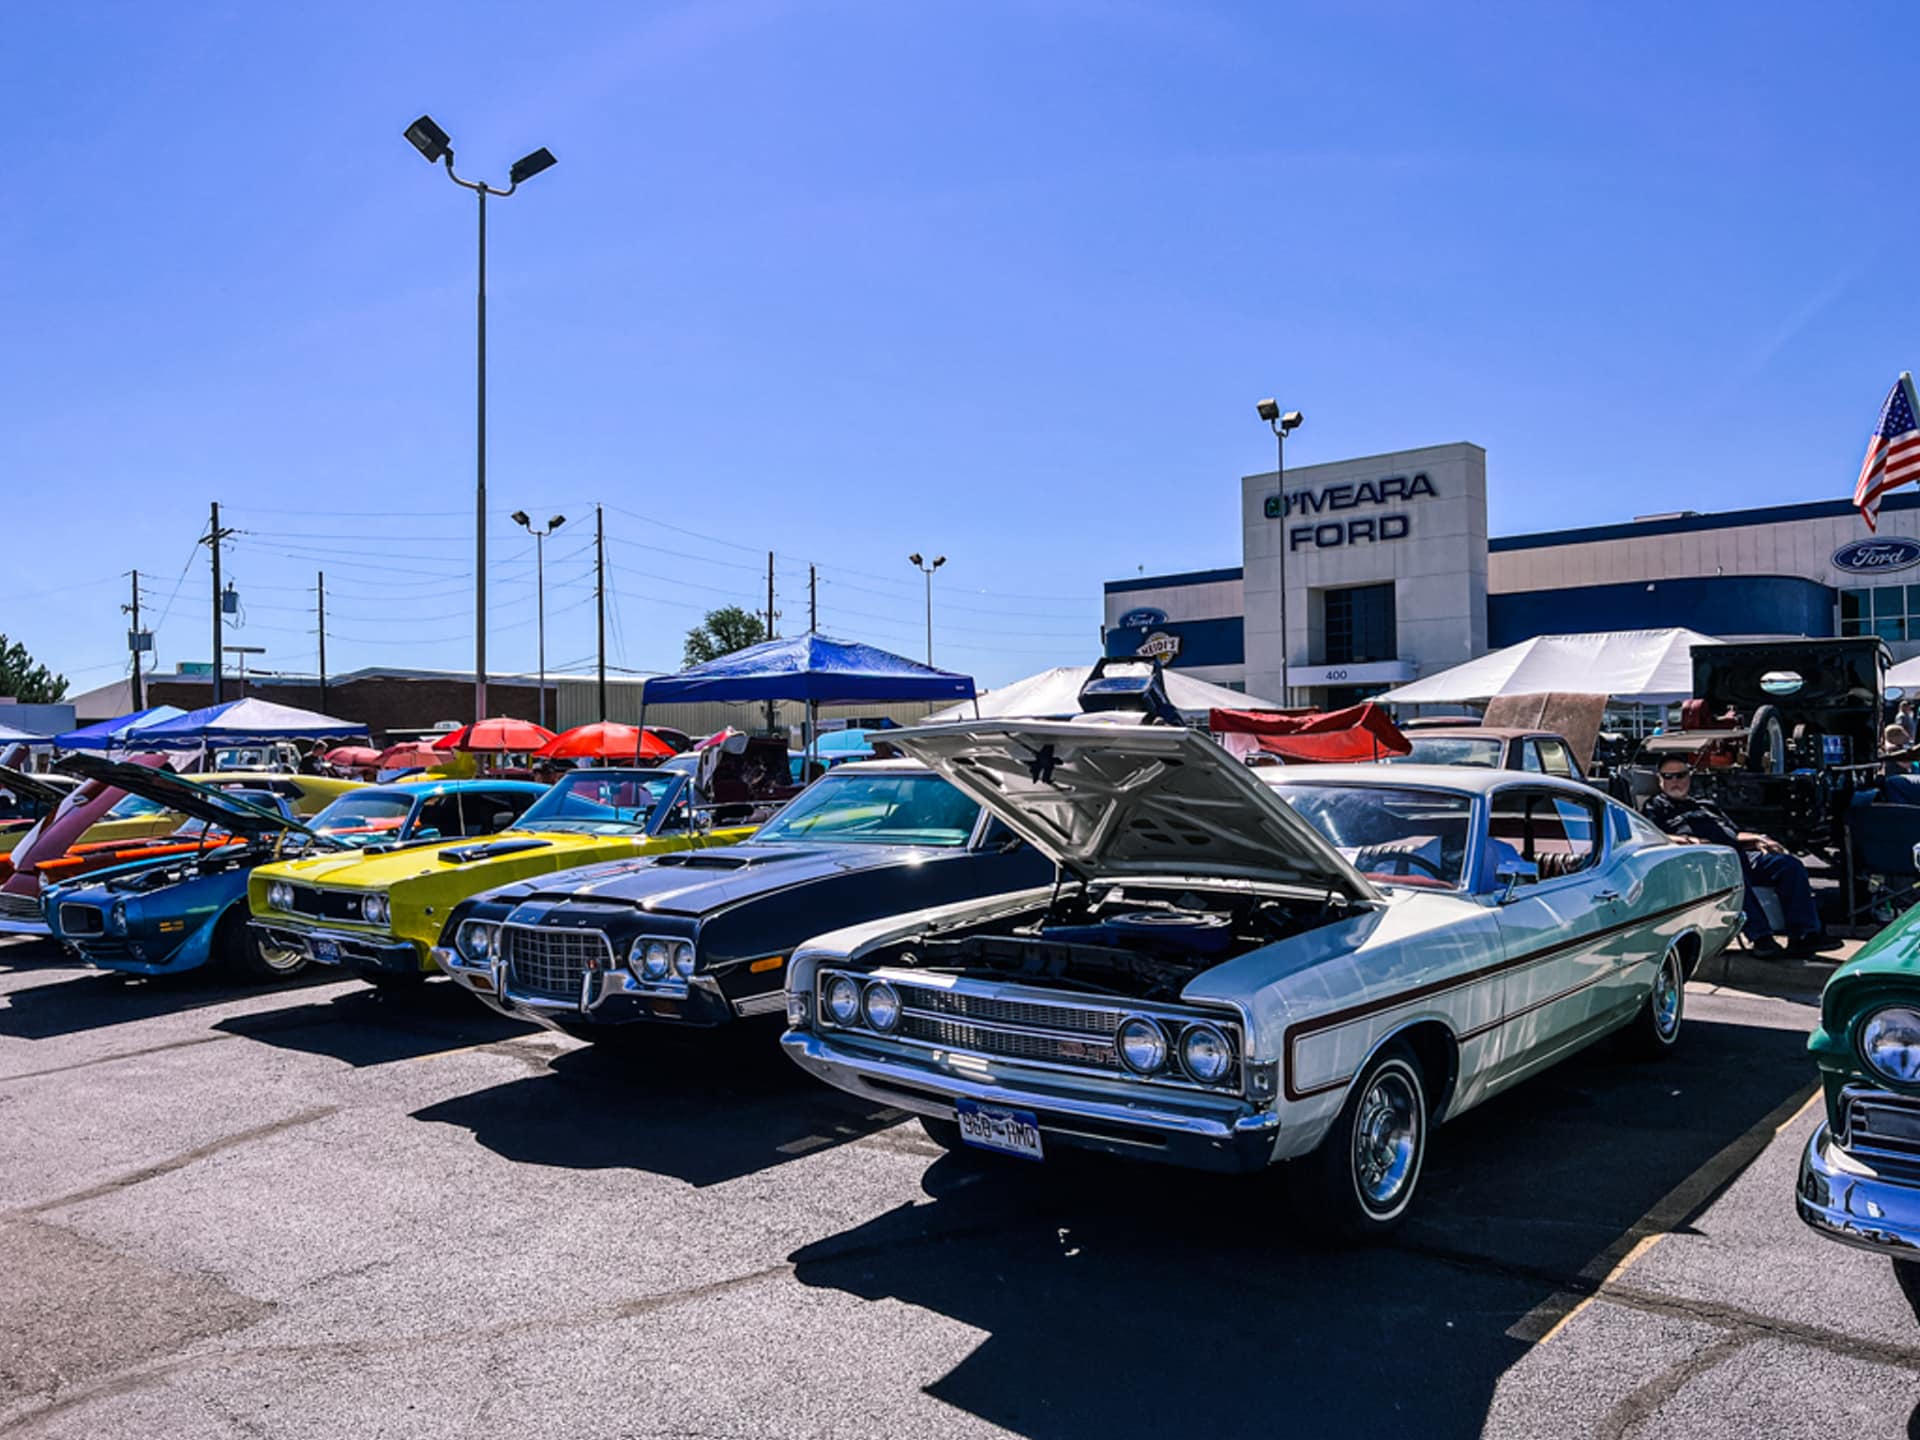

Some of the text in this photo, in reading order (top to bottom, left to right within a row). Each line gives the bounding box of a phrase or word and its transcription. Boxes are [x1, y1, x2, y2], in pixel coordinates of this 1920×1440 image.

[1264, 473, 1438, 519] O'MEARA
[1290, 514, 1409, 551] FORD
[1852, 545, 1905, 566] Ford
[1326, 670, 1348, 680] 400
